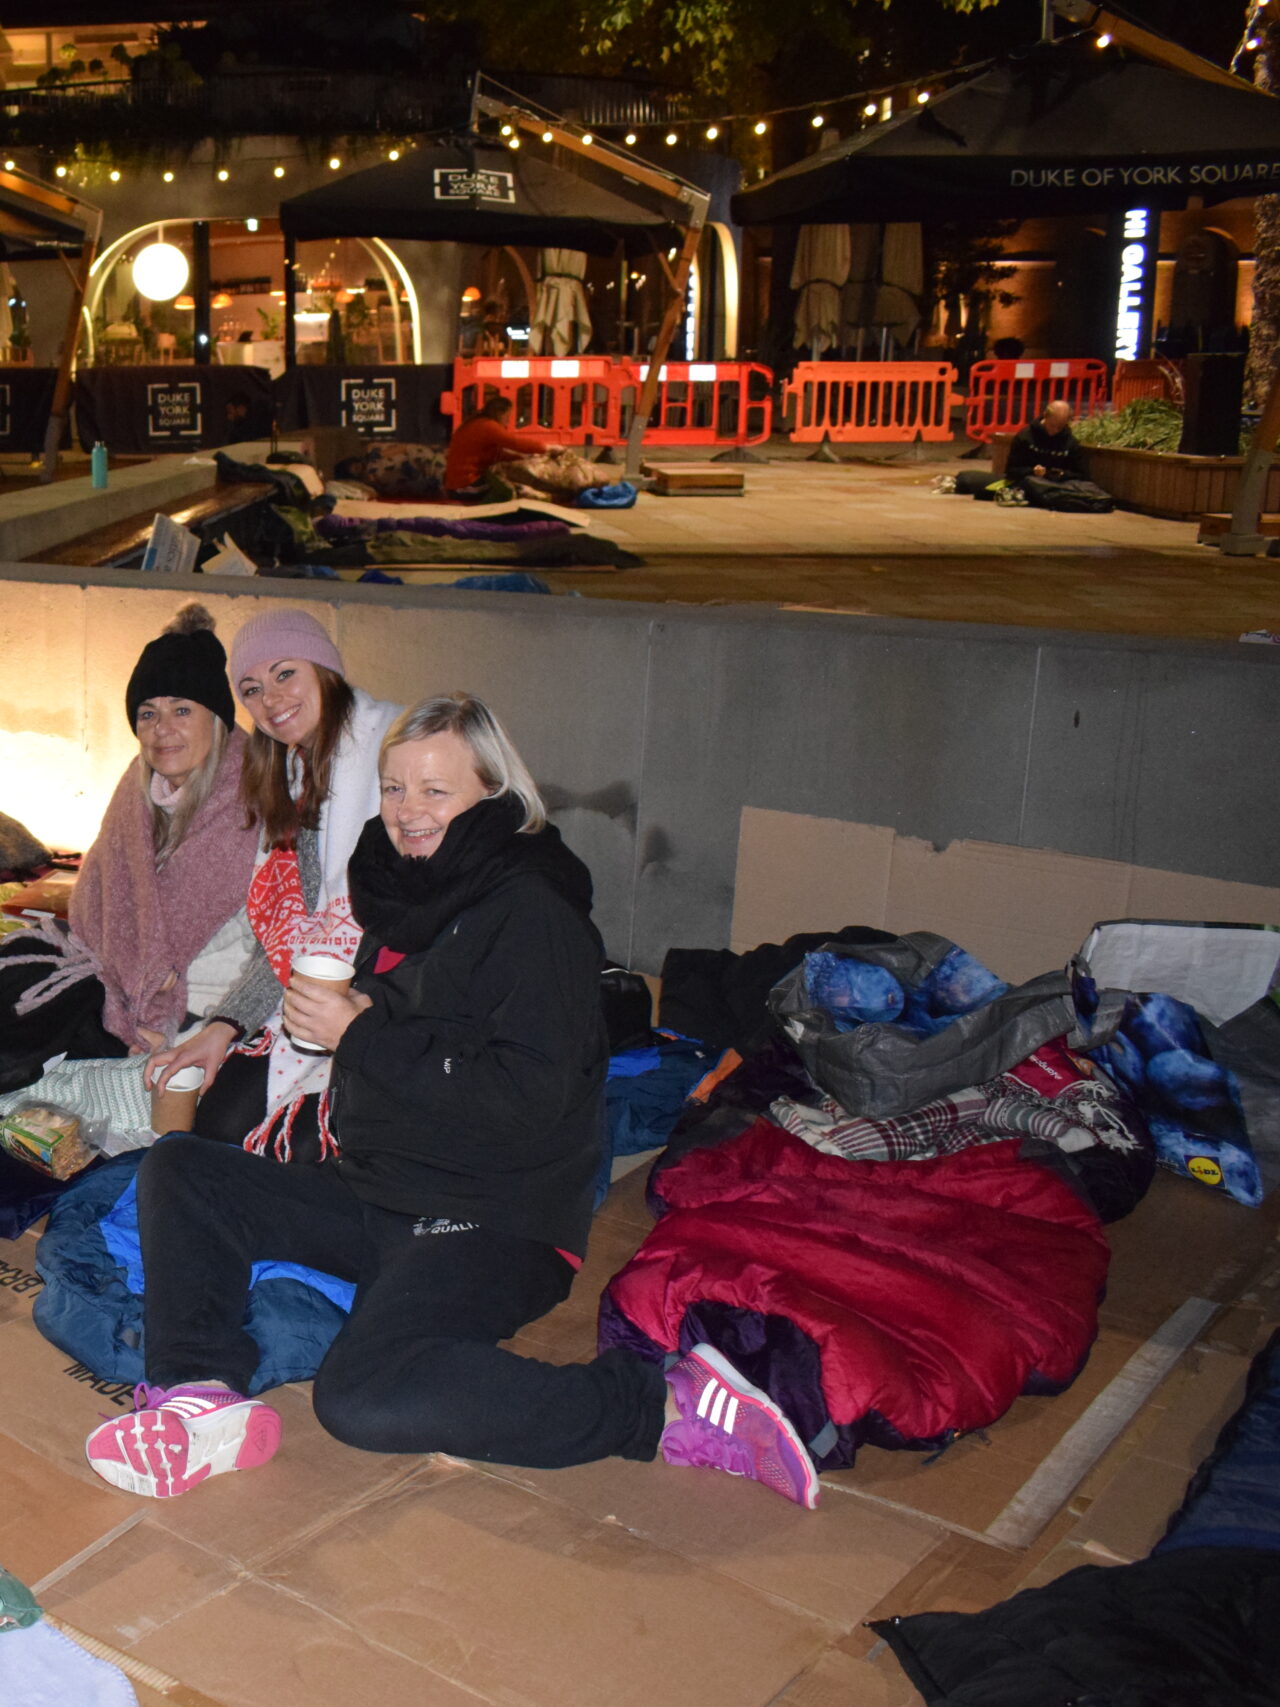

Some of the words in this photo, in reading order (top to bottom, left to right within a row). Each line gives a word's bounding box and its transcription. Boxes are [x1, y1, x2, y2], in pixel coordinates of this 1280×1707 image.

[448, 173, 499, 184] DUKE
[1010, 168, 1075, 187] DUKE
[1081, 167, 1114, 187] OF
[1120, 166, 1183, 185] YORK
[1189, 162, 1280, 183] SQUARE
[449, 182, 499, 192] YORK
[1115, 244, 1145, 361] GALLERY
[158, 392, 191, 404] DUKE
[352, 388, 385, 401] DUKE
[159, 405, 191, 416] YORK
[352, 401, 385, 412] YORK
[430, 1222, 480, 1235] QUALI
